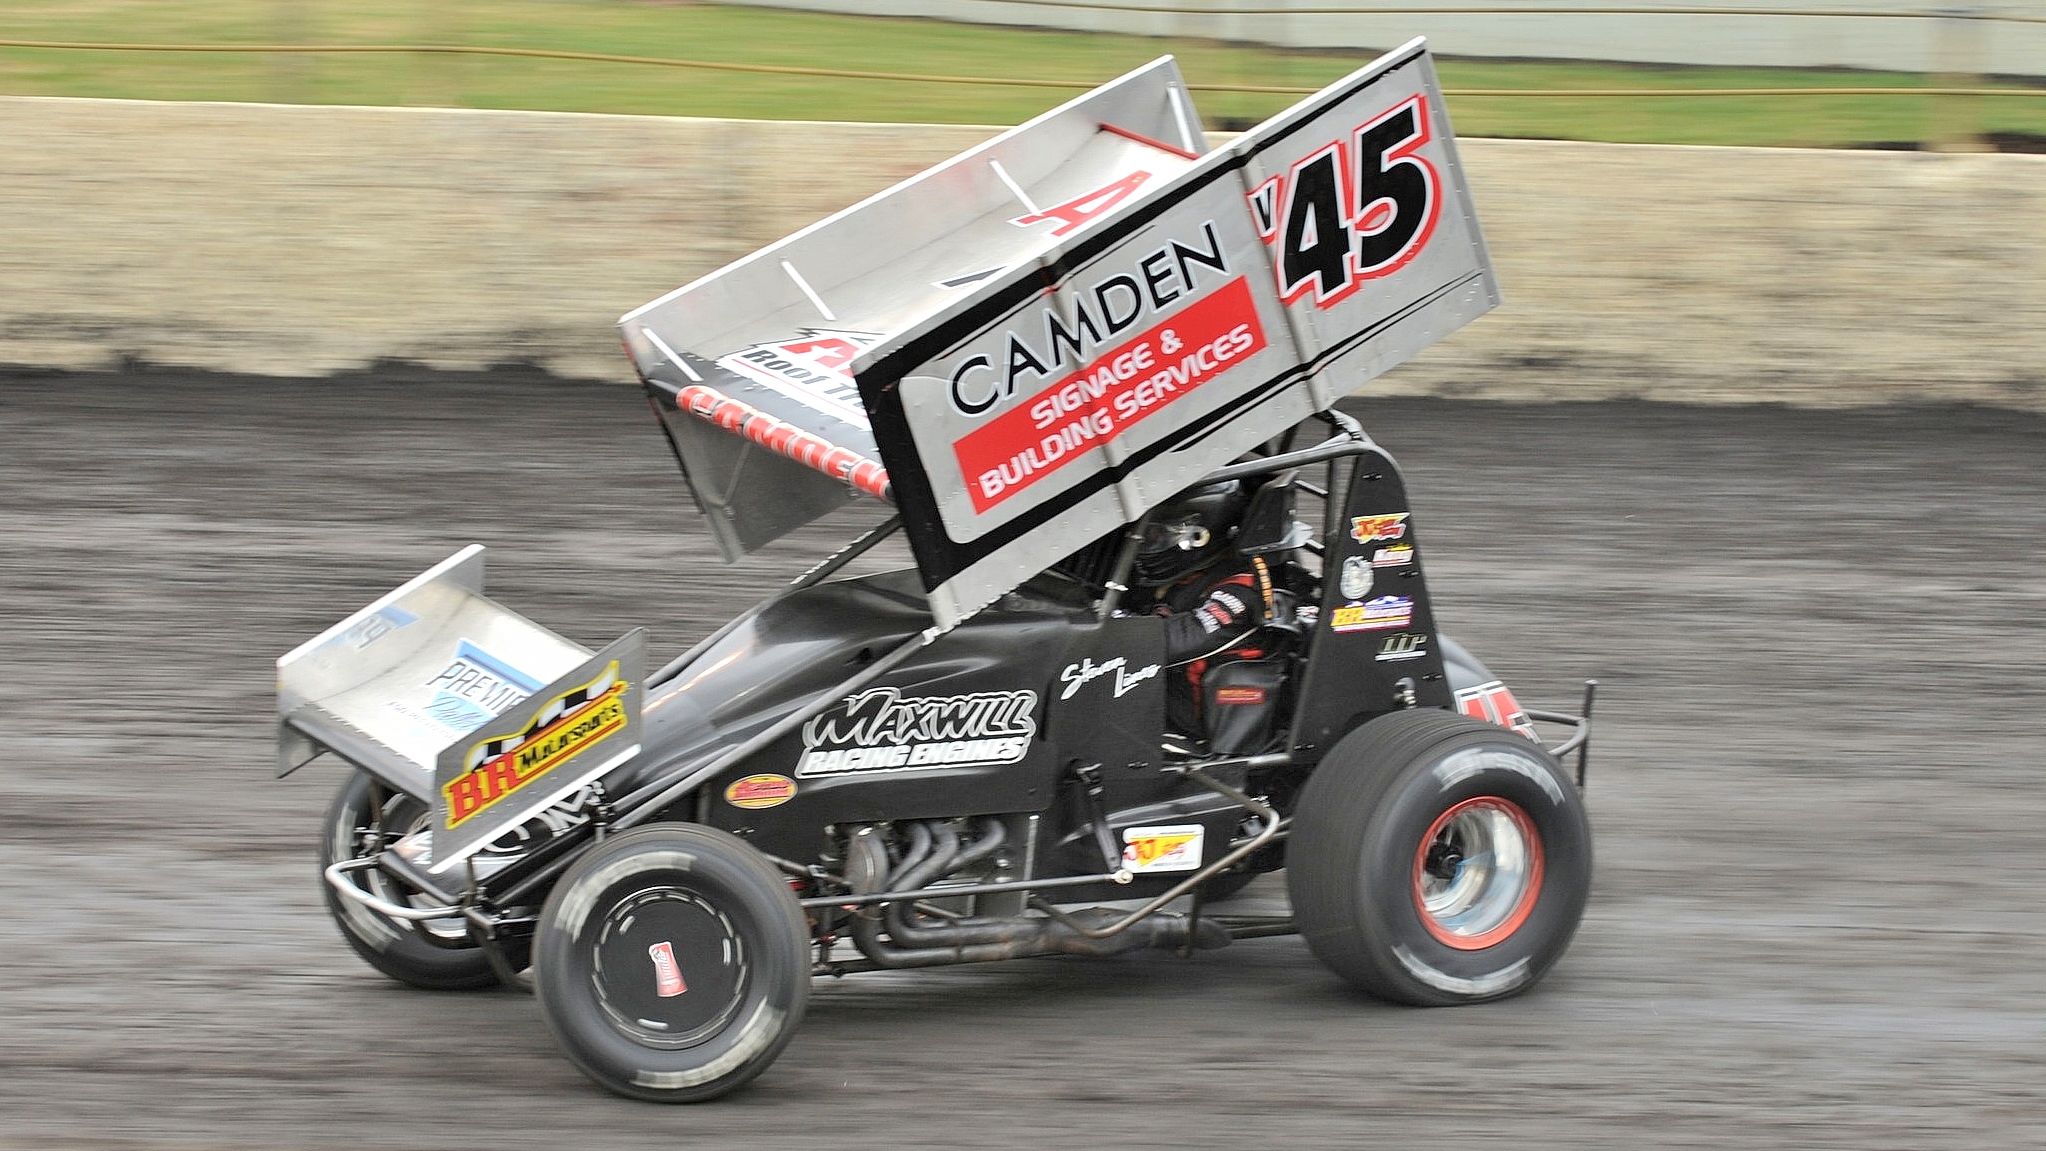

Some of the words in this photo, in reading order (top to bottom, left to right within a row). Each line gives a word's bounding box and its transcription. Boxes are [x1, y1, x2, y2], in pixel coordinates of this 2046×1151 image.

[947, 220, 1231, 418] CAMDEN
[978, 407, 1114, 499] BUILDING
[1113, 323, 1254, 420] SERVICES
[1030, 342, 1155, 430] SIGNAGE
[1159, 328, 1184, 354] &
[449, 751, 520, 823] BR
[805, 746, 911, 774] RACING
[907, 736, 1026, 766] ENGINES
